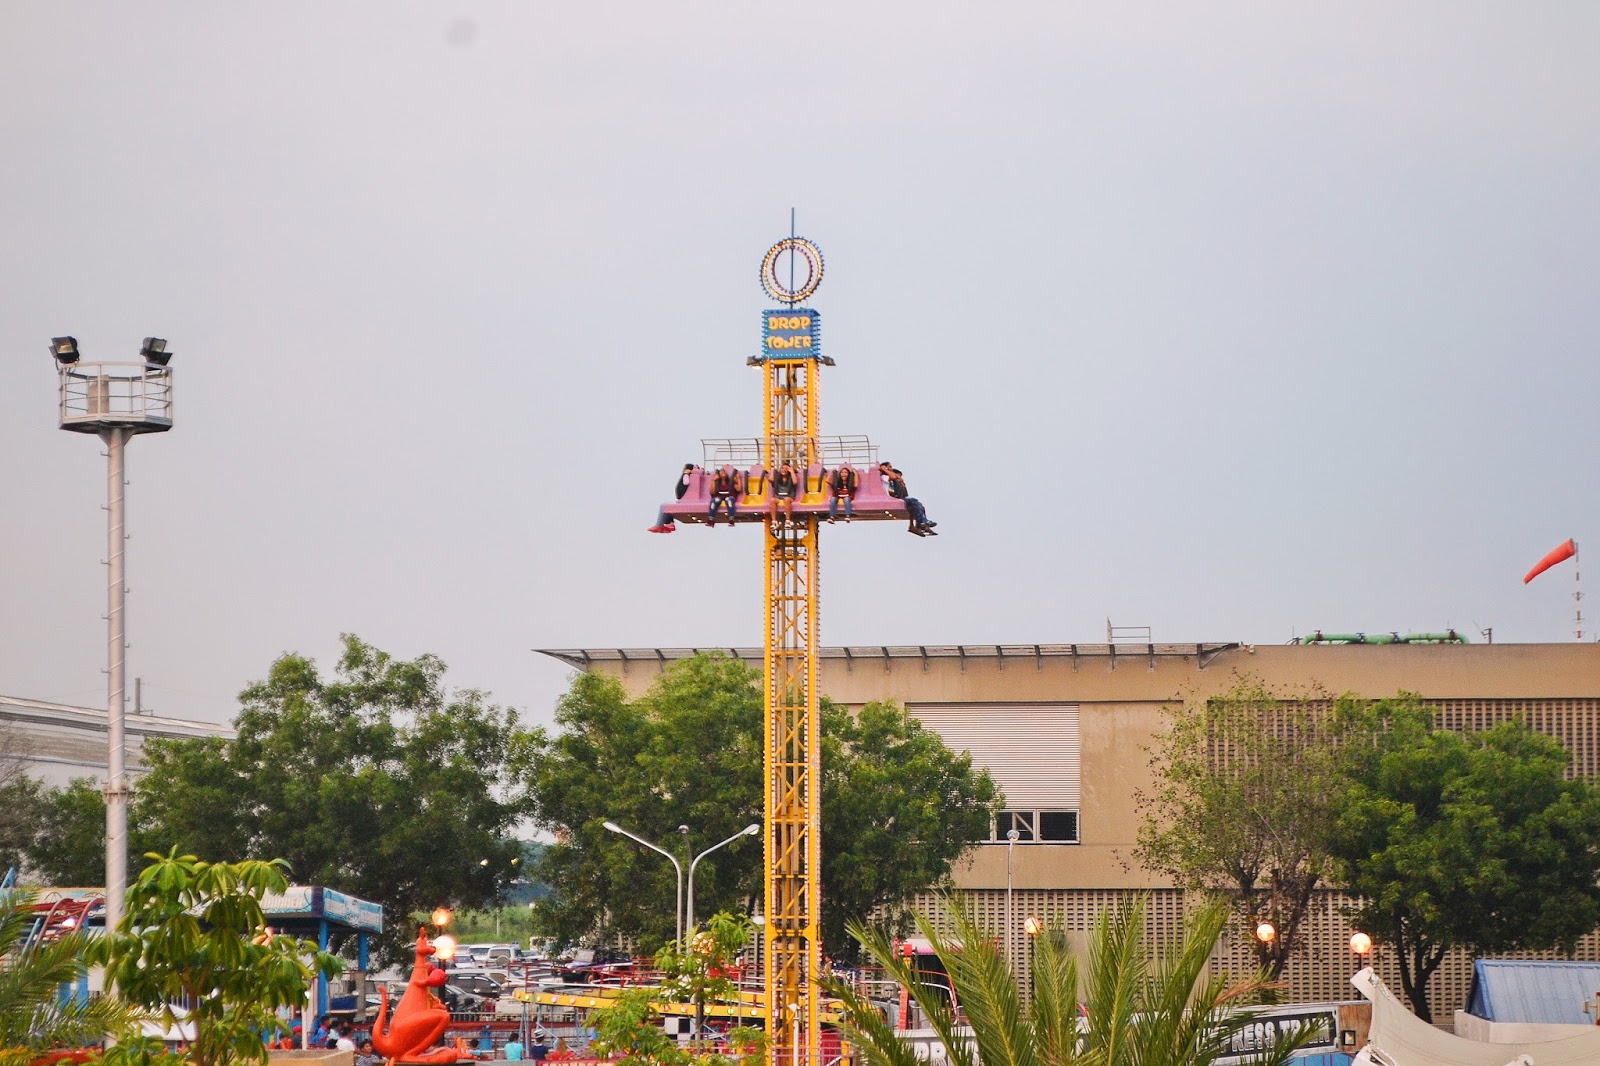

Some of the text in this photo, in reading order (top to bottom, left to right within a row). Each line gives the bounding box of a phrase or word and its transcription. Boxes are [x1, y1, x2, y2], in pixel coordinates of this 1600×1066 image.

[768, 316, 811, 330] DROP
[767, 335, 812, 349] TOWER
[1199, 1021, 1276, 1055] PRESS
